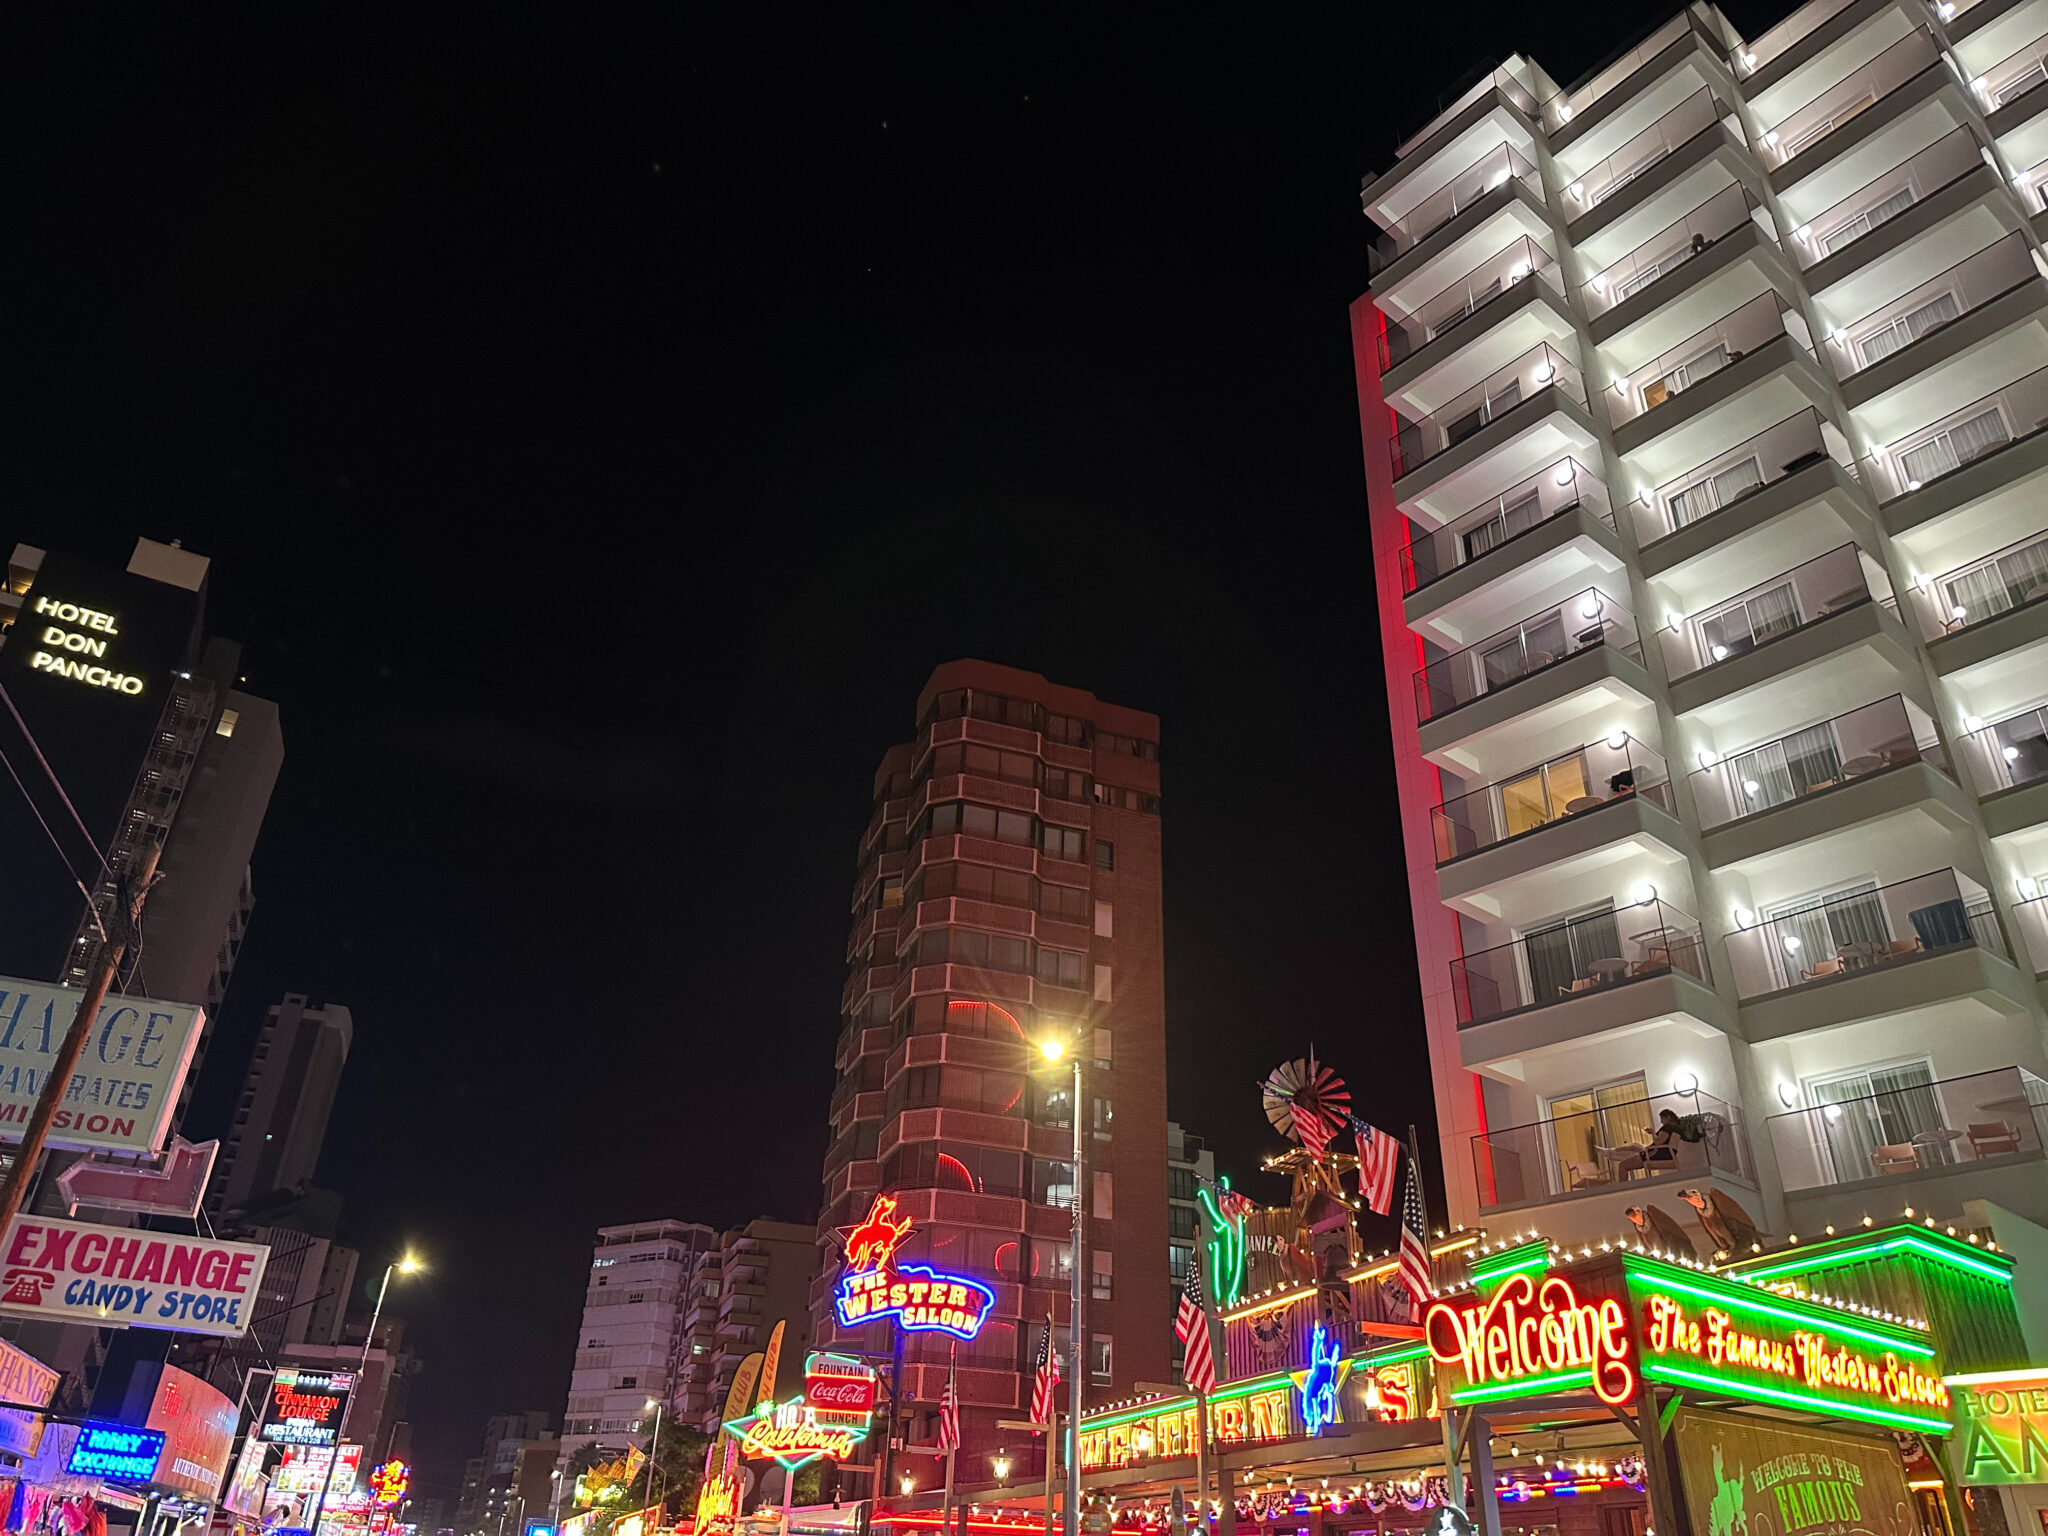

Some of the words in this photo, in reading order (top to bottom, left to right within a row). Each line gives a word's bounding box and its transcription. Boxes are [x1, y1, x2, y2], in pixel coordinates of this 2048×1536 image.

[36, 596, 118, 635] HOTEL
[43, 626, 107, 657] DON
[32, 651, 144, 695] PANCHO
[0, 990, 174, 1069] HAGE
[65, 1073, 153, 1110] RATES
[0, 1102, 136, 1137] MISION
[5, 1223, 256, 1294] EXCHANGE
[849, 1272, 887, 1294] THE
[64, 1278, 153, 1315] CANDY
[157, 1290, 242, 1326] STORE
[843, 1282, 984, 1320] WESTERN
[904, 1306, 978, 1332] SALOON
[1426, 1273, 1634, 1404] Welcome
[1649, 1292, 1702, 1354] The
[1705, 1306, 1796, 1377] Famous
[1793, 1329, 1882, 1396] Western
[1883, 1351, 1950, 1409] Saloon
[818, 1363, 864, 1377] FOUNTAIN
[274, 1383, 294, 1394] THE
[275, 1393, 340, 1410] CINNAMON
[809, 1382, 868, 1404] Coca-Cola
[279, 1406, 330, 1421] LOUNGE
[825, 1411, 859, 1425] LUNCH
[88, 1429, 143, 1453] MONEY
[263, 1423, 336, 1440] RESTAURANT
[742, 1420, 856, 1460] California
[71, 1450, 154, 1475] EXCHANGE
[1750, 1453, 1811, 1494] WELCOME
[1810, 1453, 1832, 1476] TO
[1832, 1456, 1864, 1487] THE
[1774, 1480, 1862, 1533] FAMOUS
